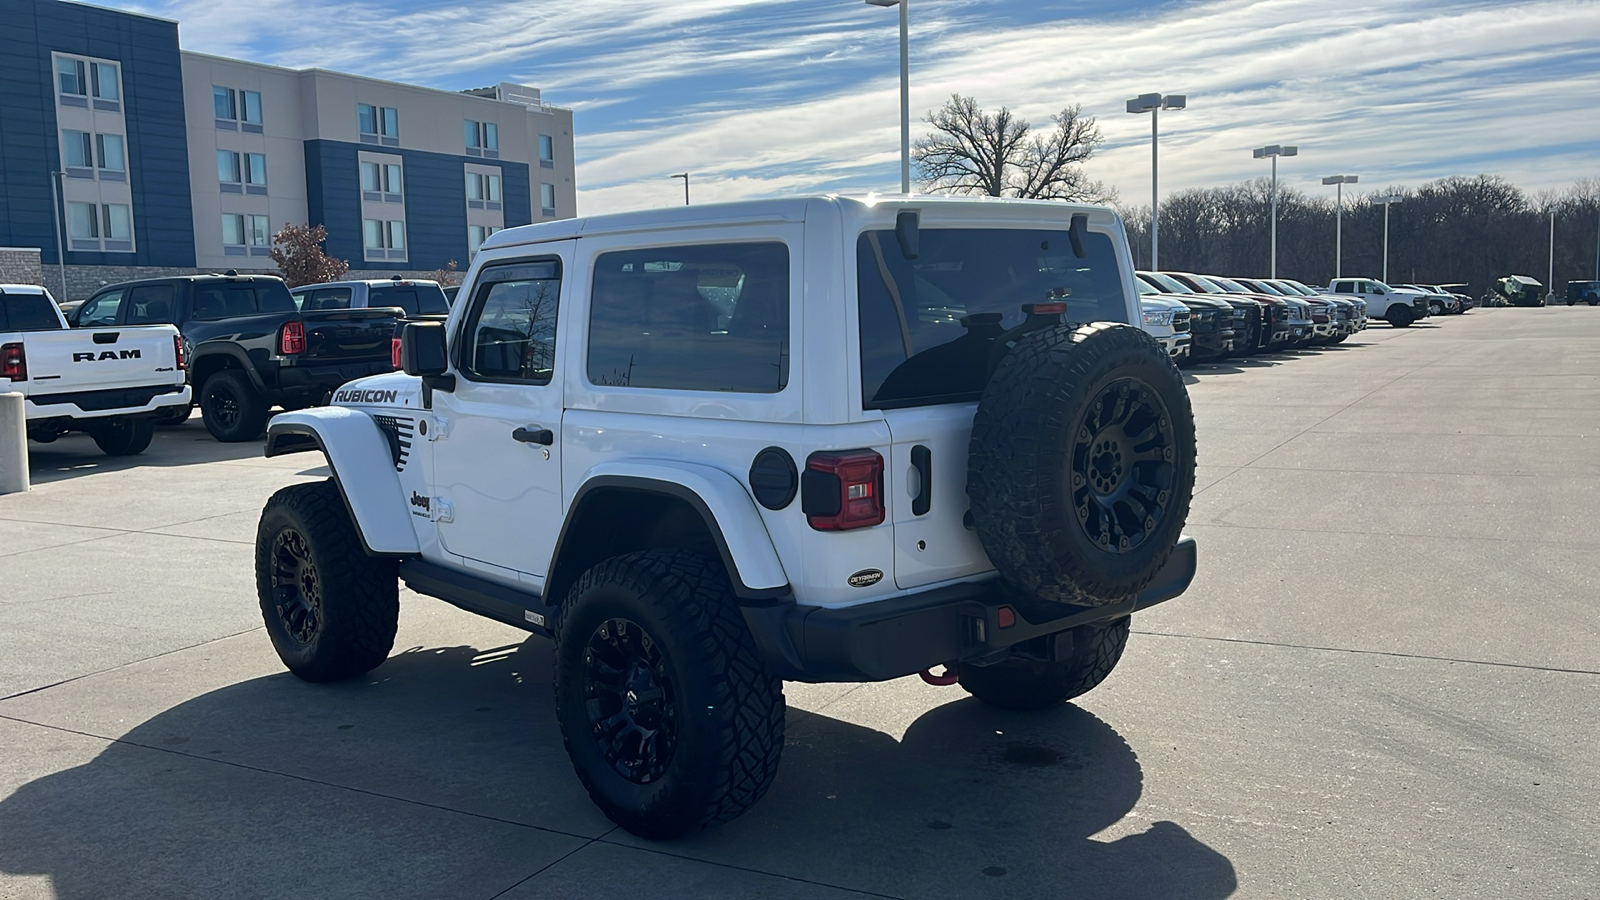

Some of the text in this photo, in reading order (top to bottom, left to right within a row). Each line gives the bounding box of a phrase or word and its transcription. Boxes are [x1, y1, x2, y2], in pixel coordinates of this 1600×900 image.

[73, 350, 141, 362] RAM
[334, 390, 398, 403] RUBICON
[411, 490, 430, 511] Jeep
